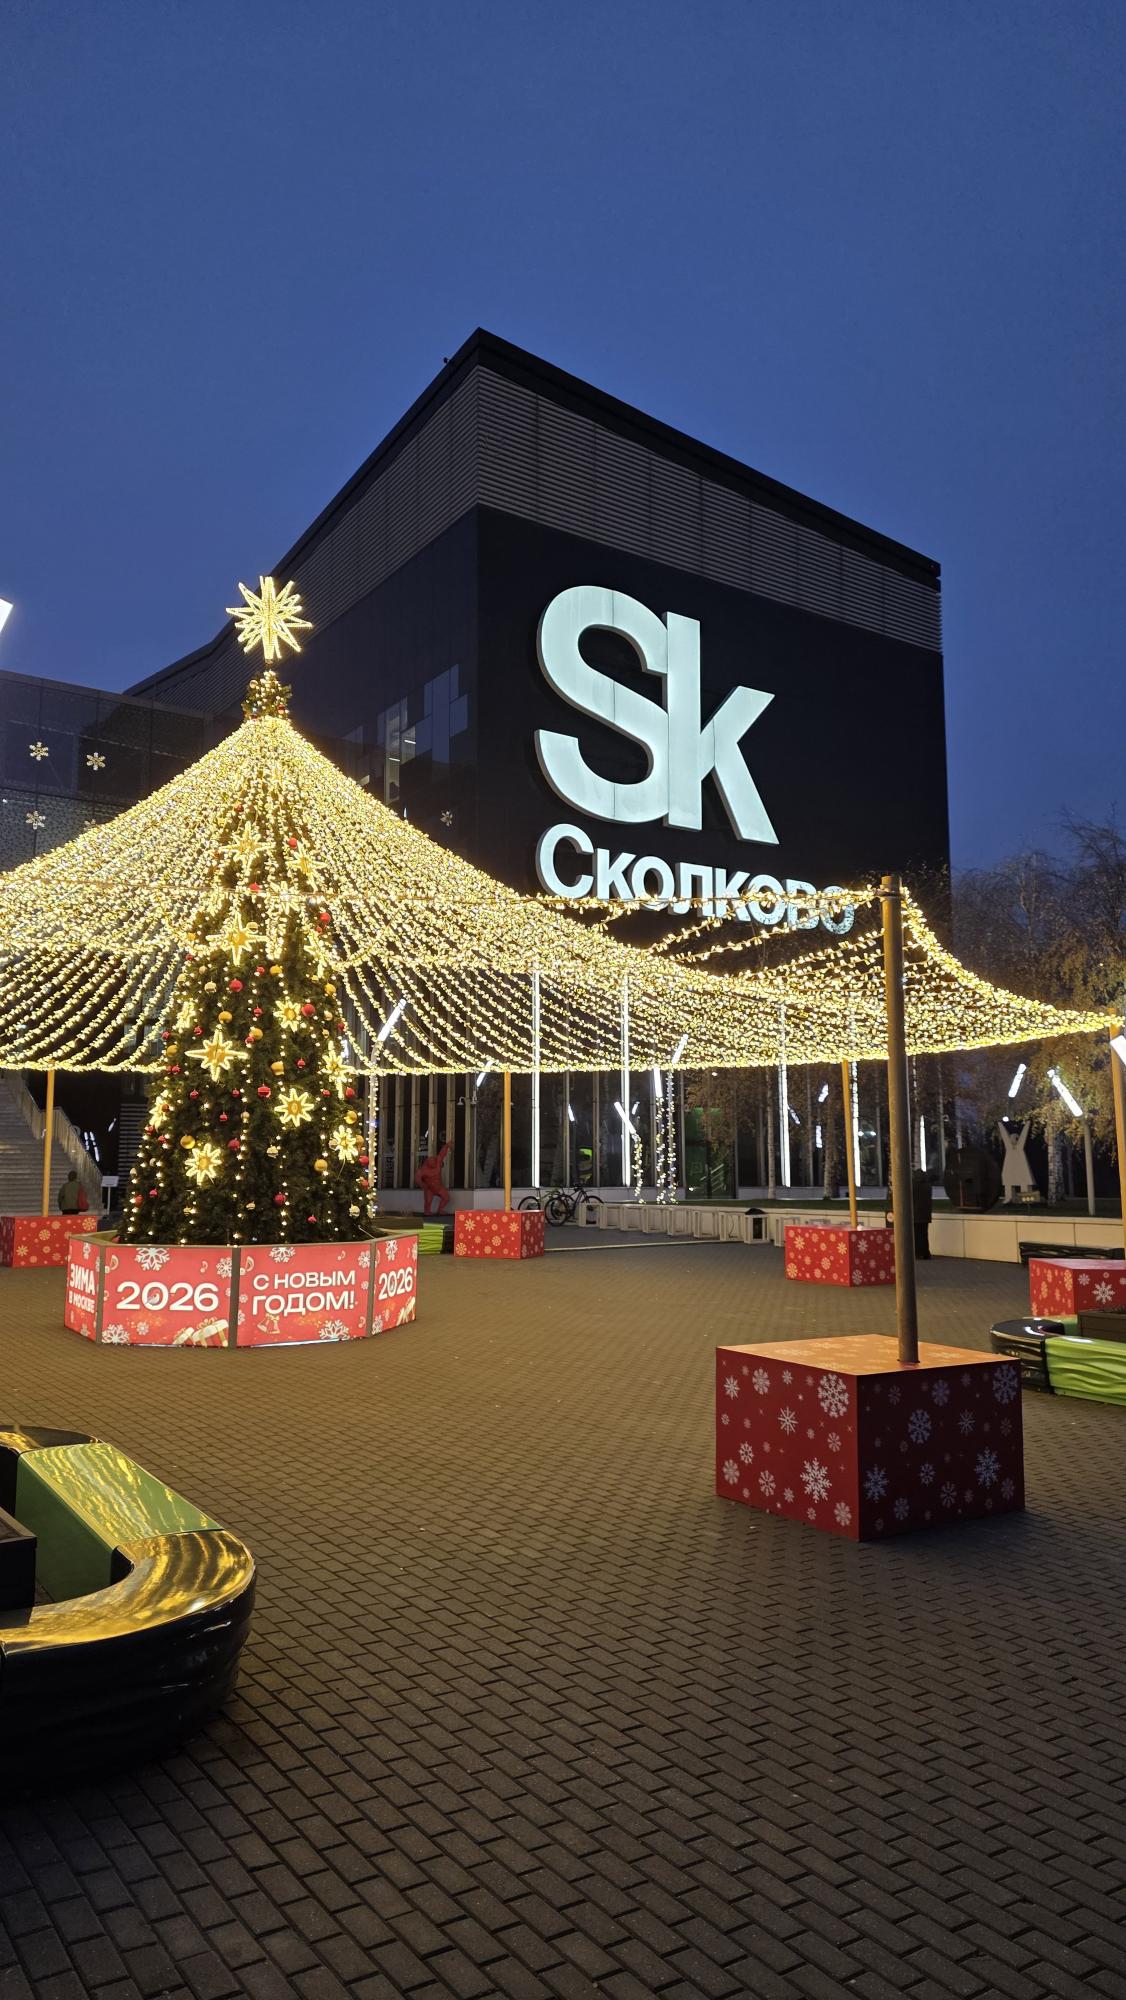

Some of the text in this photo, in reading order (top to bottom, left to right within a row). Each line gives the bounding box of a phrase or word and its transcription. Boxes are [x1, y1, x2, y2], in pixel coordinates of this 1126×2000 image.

[535, 585, 779, 845] Sk
[70, 1263, 96, 1296] ЗИМА
[253, 1270, 356, 1291] С НОВЫМ
[379, 1266, 414, 1300] 2026
[116, 1281, 219, 1311] 2026
[252, 1290, 355, 1317] ГОДОМ!
